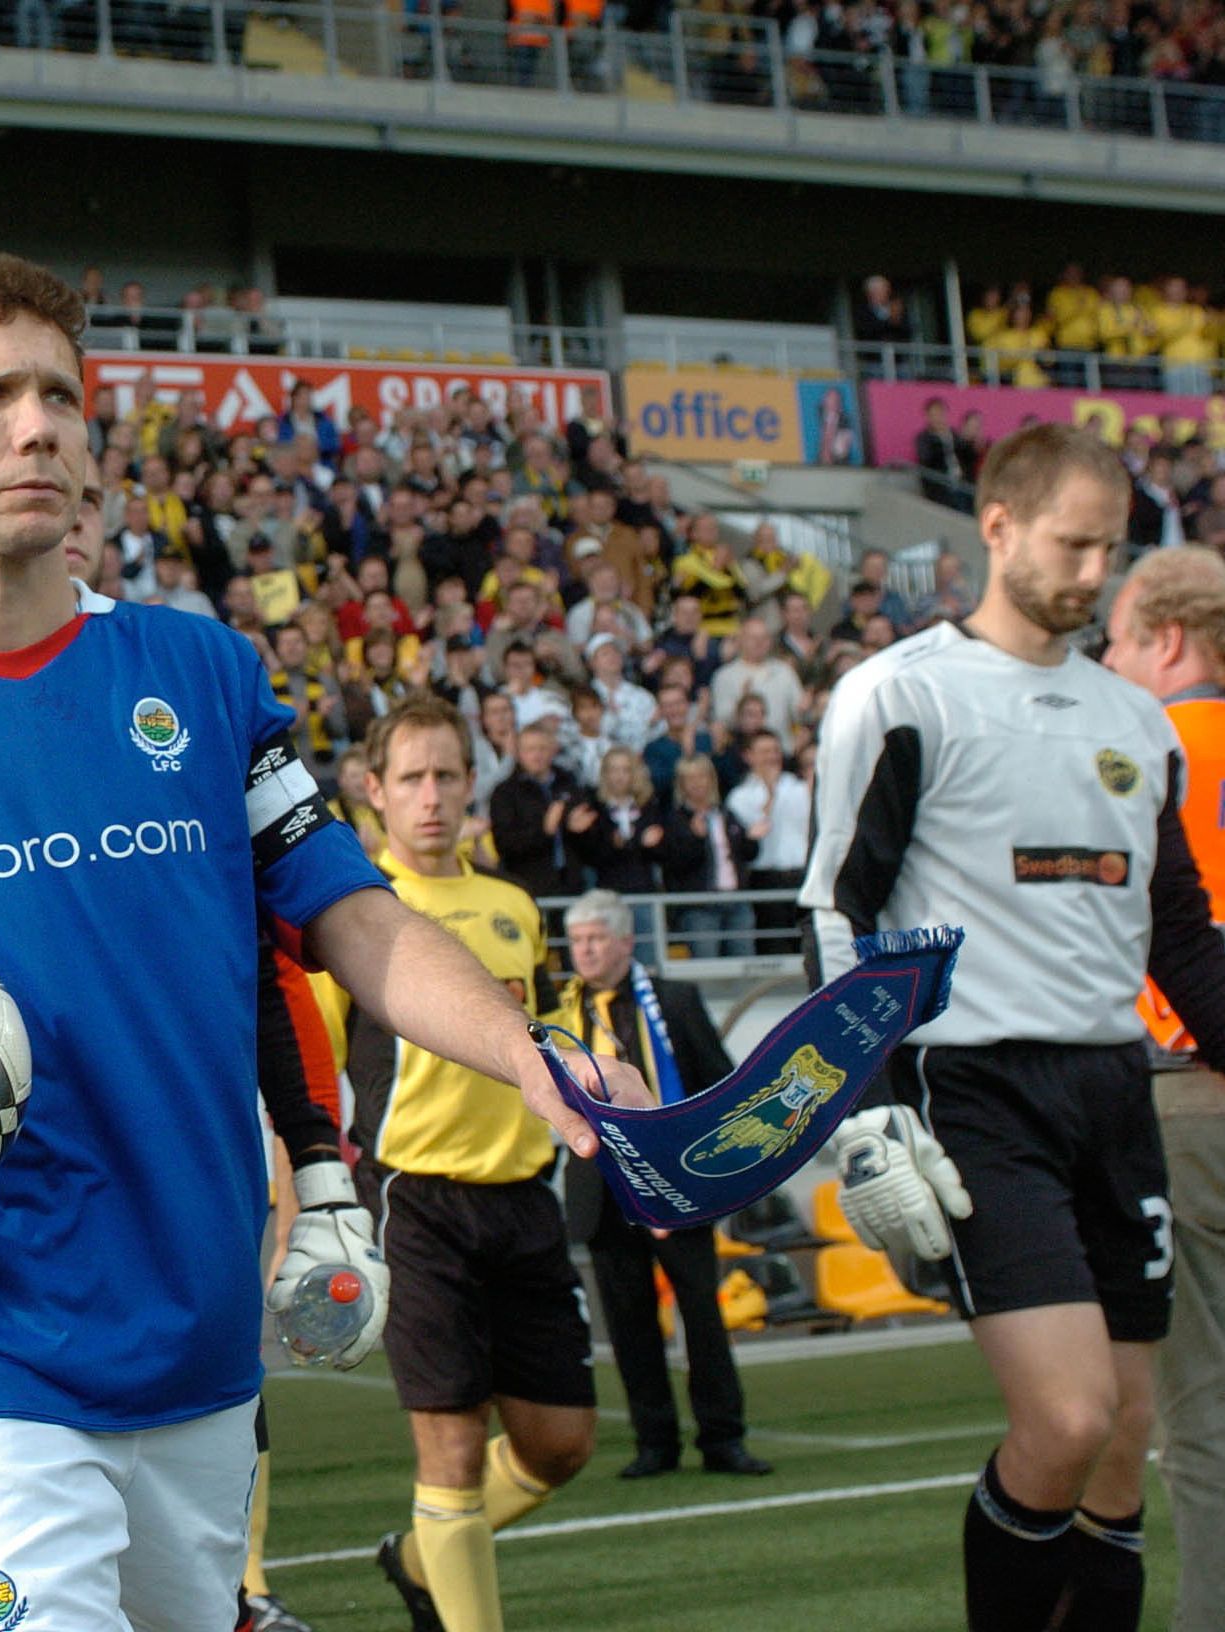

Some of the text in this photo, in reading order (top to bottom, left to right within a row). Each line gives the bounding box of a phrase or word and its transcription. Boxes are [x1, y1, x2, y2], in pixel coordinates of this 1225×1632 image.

[98, 364, 351, 434] TEAM
[642, 391, 780, 443] office
[152, 759, 182, 771] LFC
[600, 1120, 700, 1214] FOOTBALL CLUB
